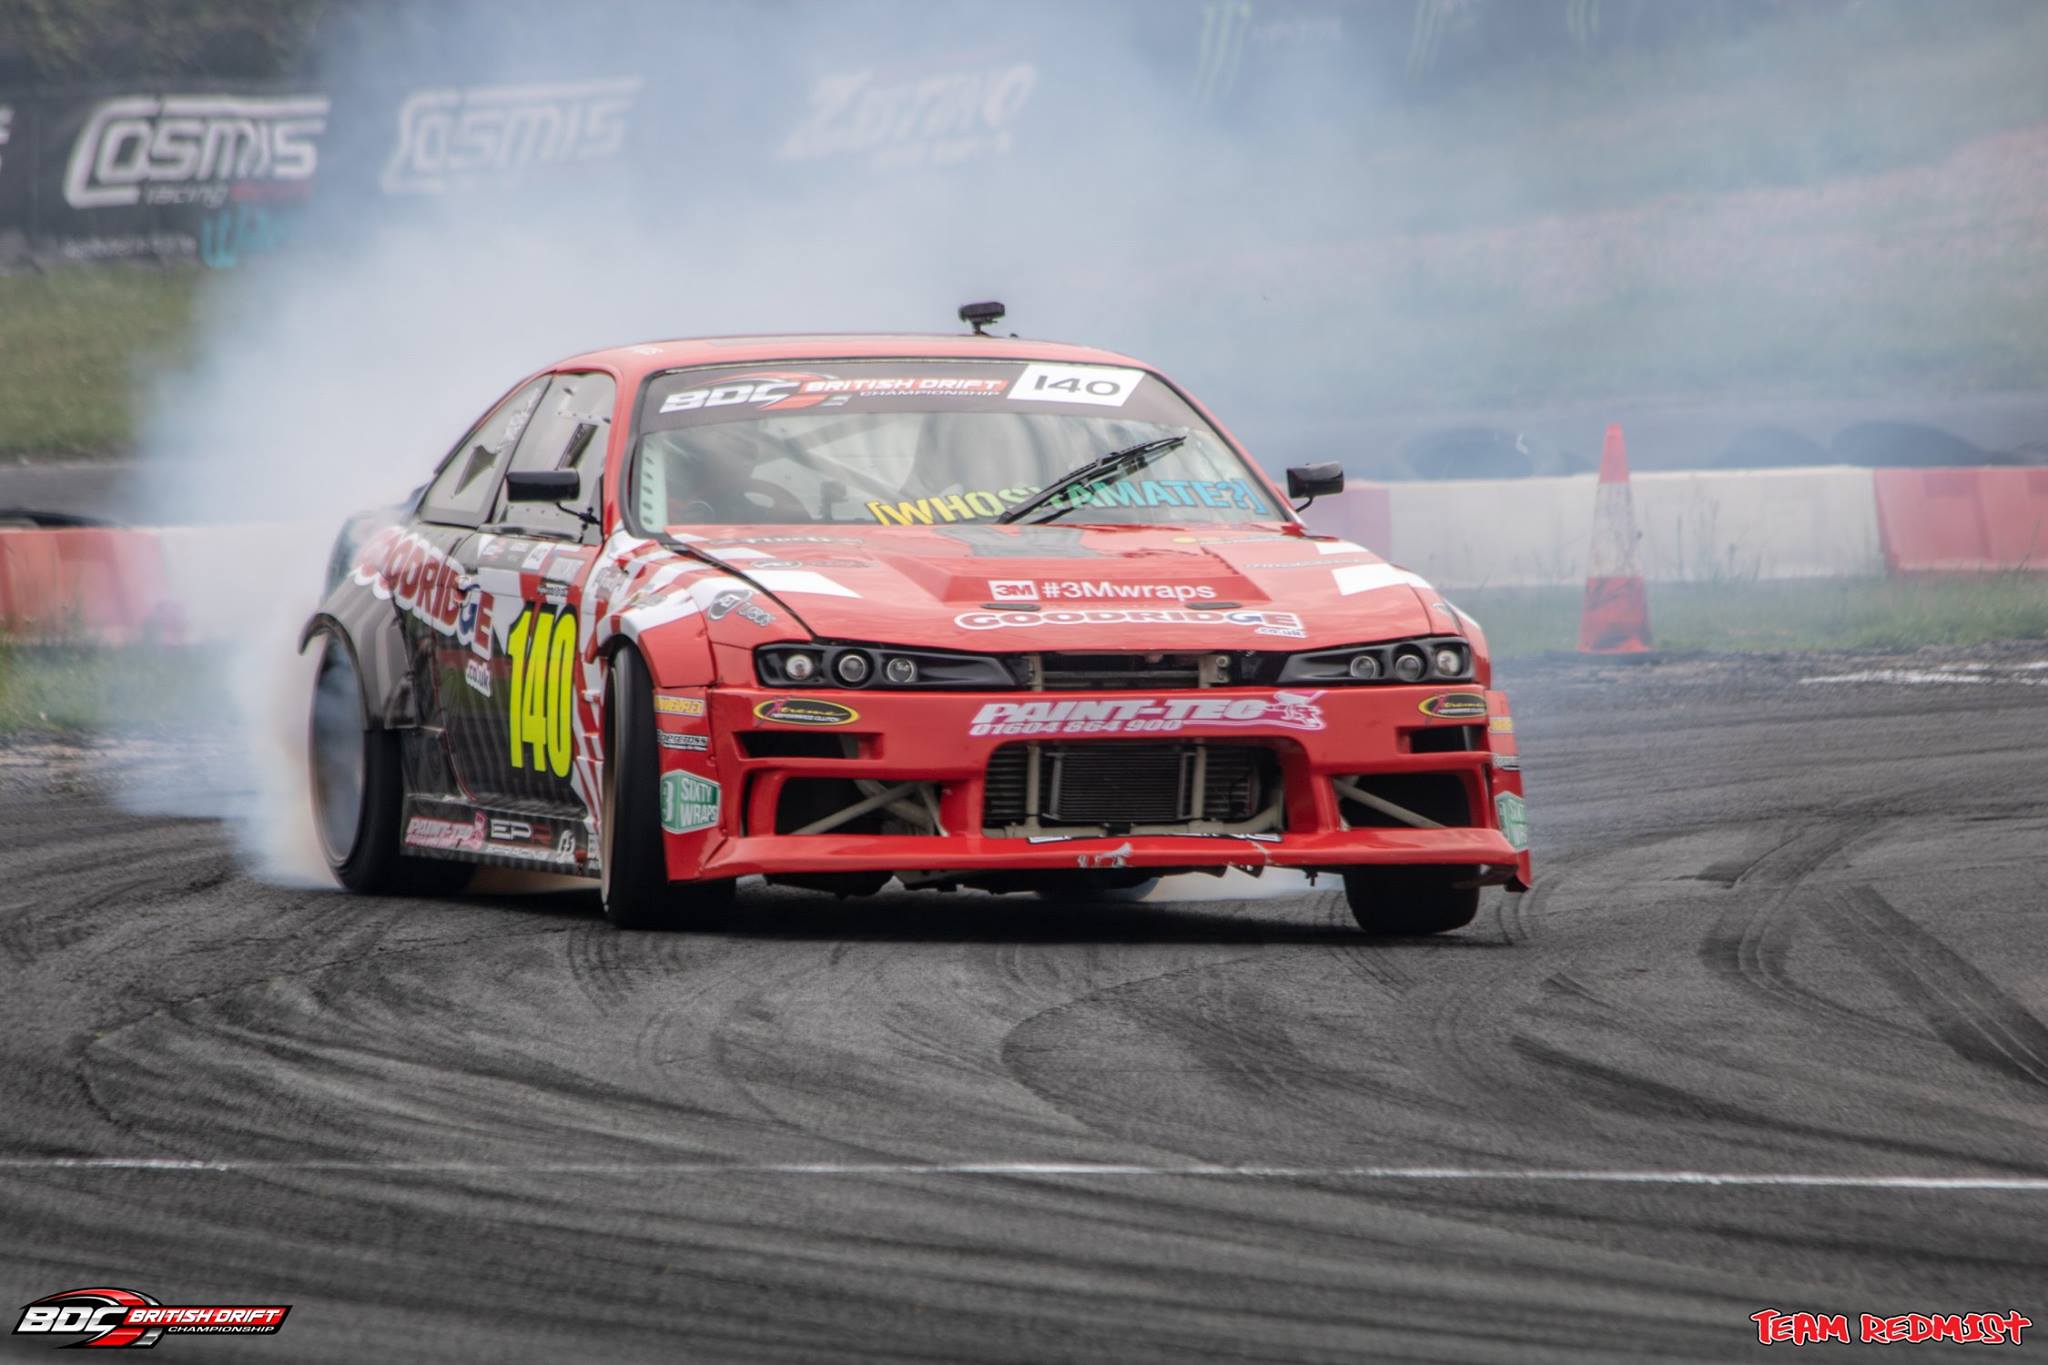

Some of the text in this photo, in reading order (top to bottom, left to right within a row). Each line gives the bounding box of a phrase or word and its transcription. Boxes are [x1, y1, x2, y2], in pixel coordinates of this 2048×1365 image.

[659, 377, 1002, 414] BDC BRITISH DRIFT
[860, 389, 1001, 397] CHAMPIONSHIP
[1034, 374, 1121, 396] 140
[995, 581, 1217, 601] 3M #3Mwraps
[954, 610, 1304, 631] GOODRIDGE
[507, 610, 577, 778] 140
[970, 699, 1268, 724] PAINT-TEC
[970, 718, 1184, 737] 01604 864 900
[681, 777, 712, 802] SIXTY
[680, 803, 718, 827] WRAPS
